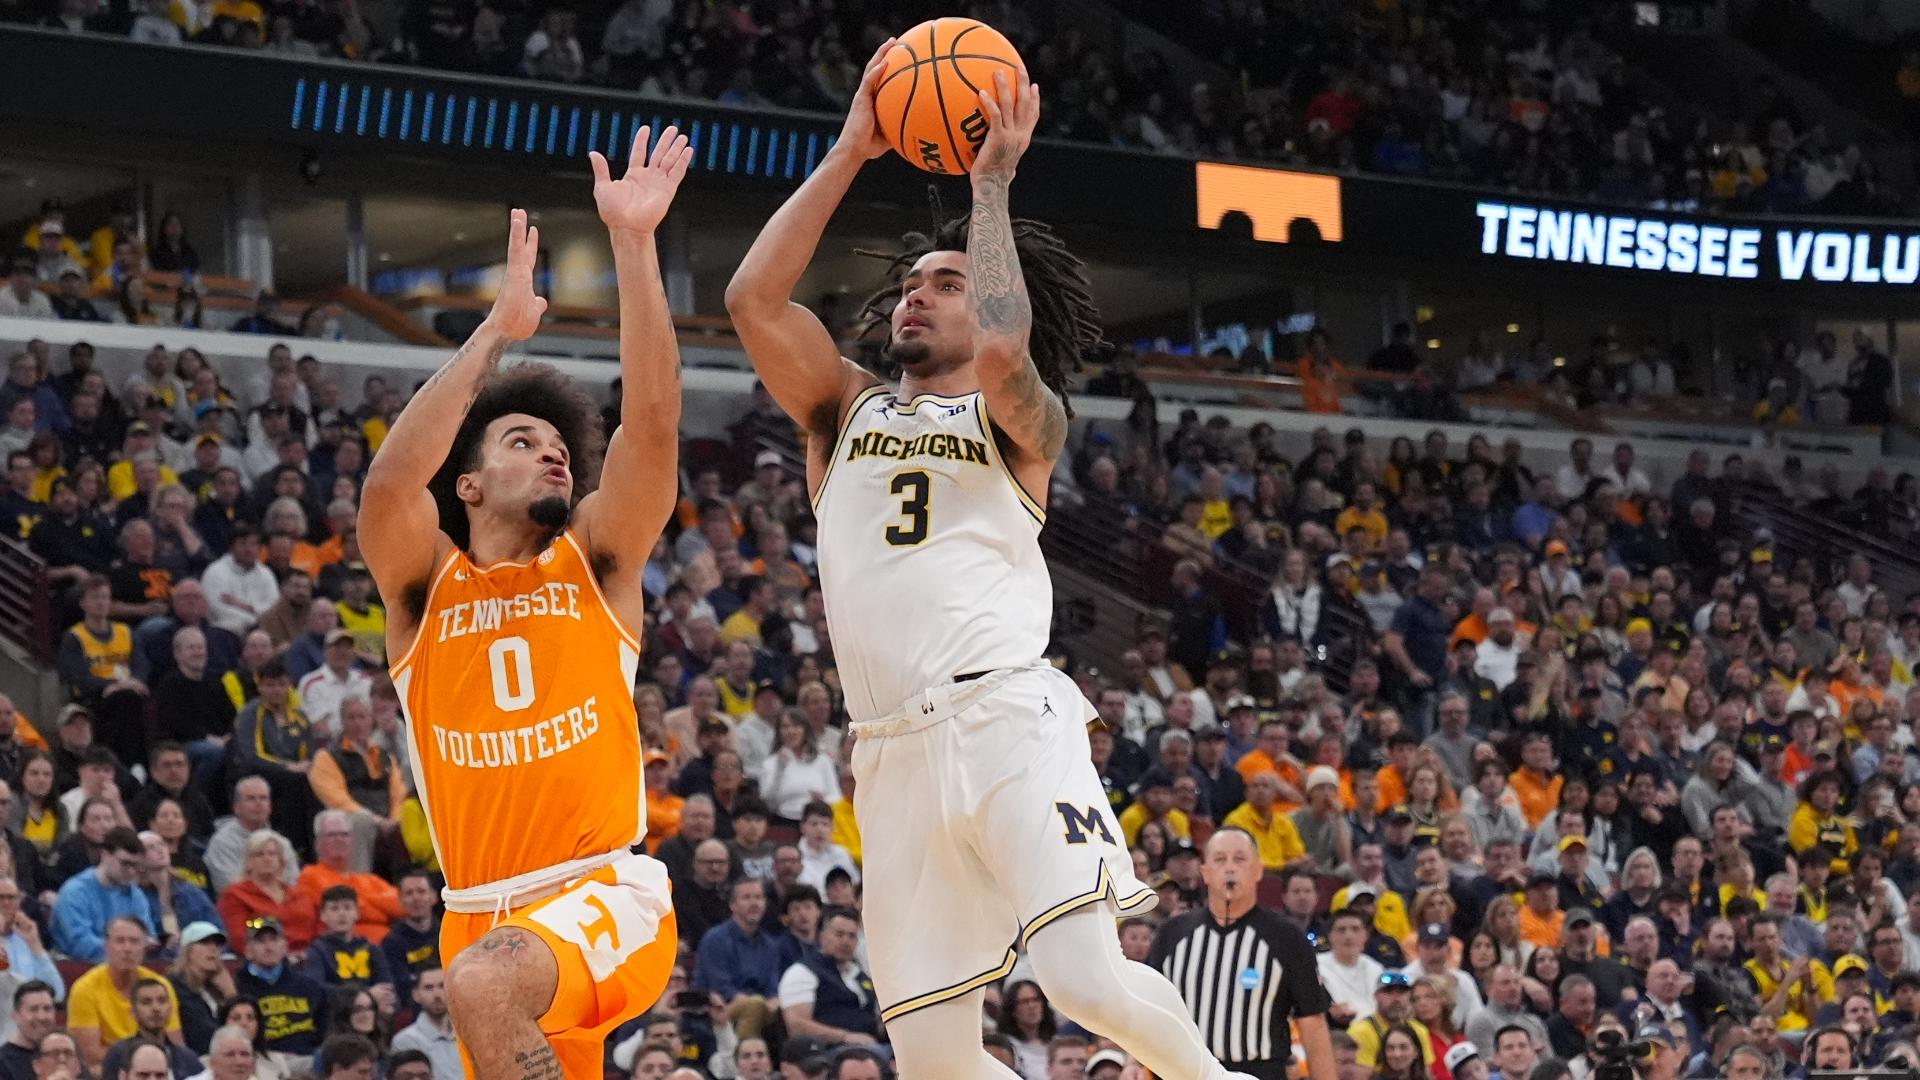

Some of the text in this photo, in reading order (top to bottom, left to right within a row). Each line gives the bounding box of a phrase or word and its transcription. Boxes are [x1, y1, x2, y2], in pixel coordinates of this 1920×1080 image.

[1476, 201, 1920, 284] TENNESSEE VOLU
[847, 430, 990, 466] MICHIGAN
[885, 469, 932, 547] 3
[488, 636, 536, 712] 0
[432, 696, 599, 768] VOLUNTEERS
[1053, 801, 1118, 847] M
[335, 948, 371, 979] M
